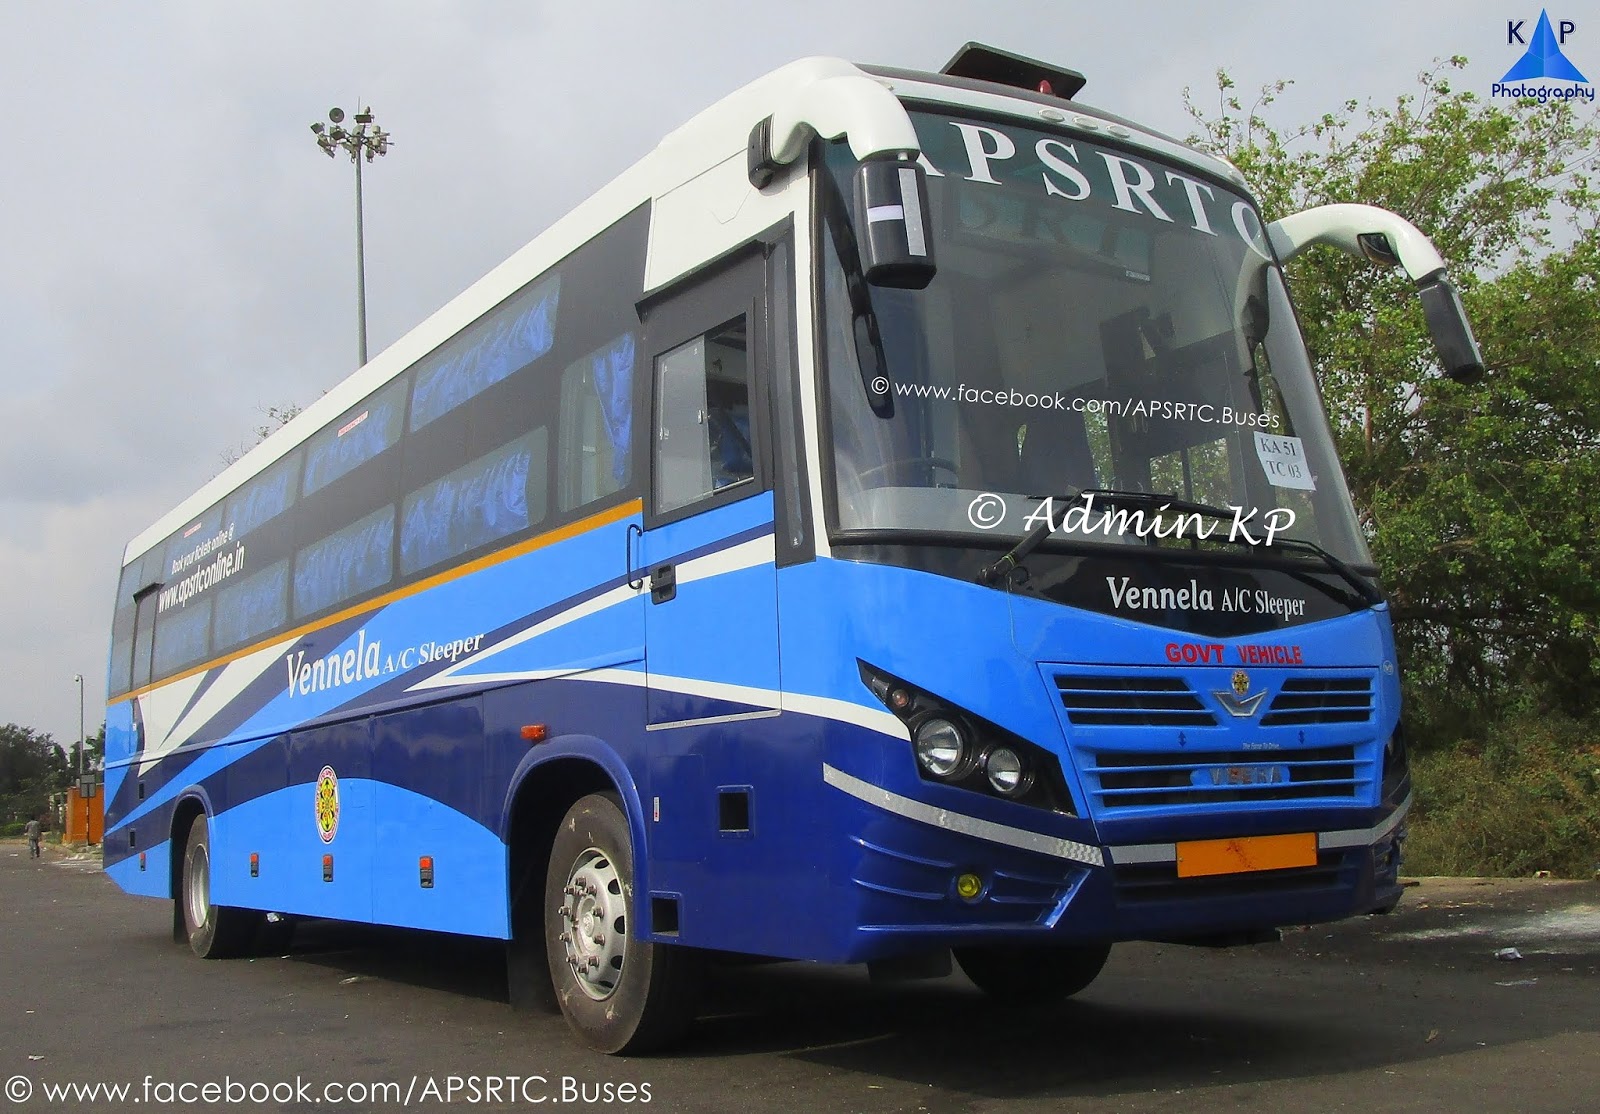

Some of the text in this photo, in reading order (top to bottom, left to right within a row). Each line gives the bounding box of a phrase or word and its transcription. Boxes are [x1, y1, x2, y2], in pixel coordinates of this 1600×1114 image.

[1261, 438, 1296, 456] KA 51
[1266, 460, 1302, 479] TC 03
[171, 555, 184, 574] Book
[182, 551, 196, 572] your
[194, 538, 211, 562] tickets
[211, 530, 228, 551] online
[159, 541, 245, 613] www.apsrtconline.in
[1106, 576, 1306, 621] Vennela A/C Sleeper
[287, 629, 485, 698] Vennela A/C Sleeper
[1165, 643, 1303, 664] GOVT VEHICLE
